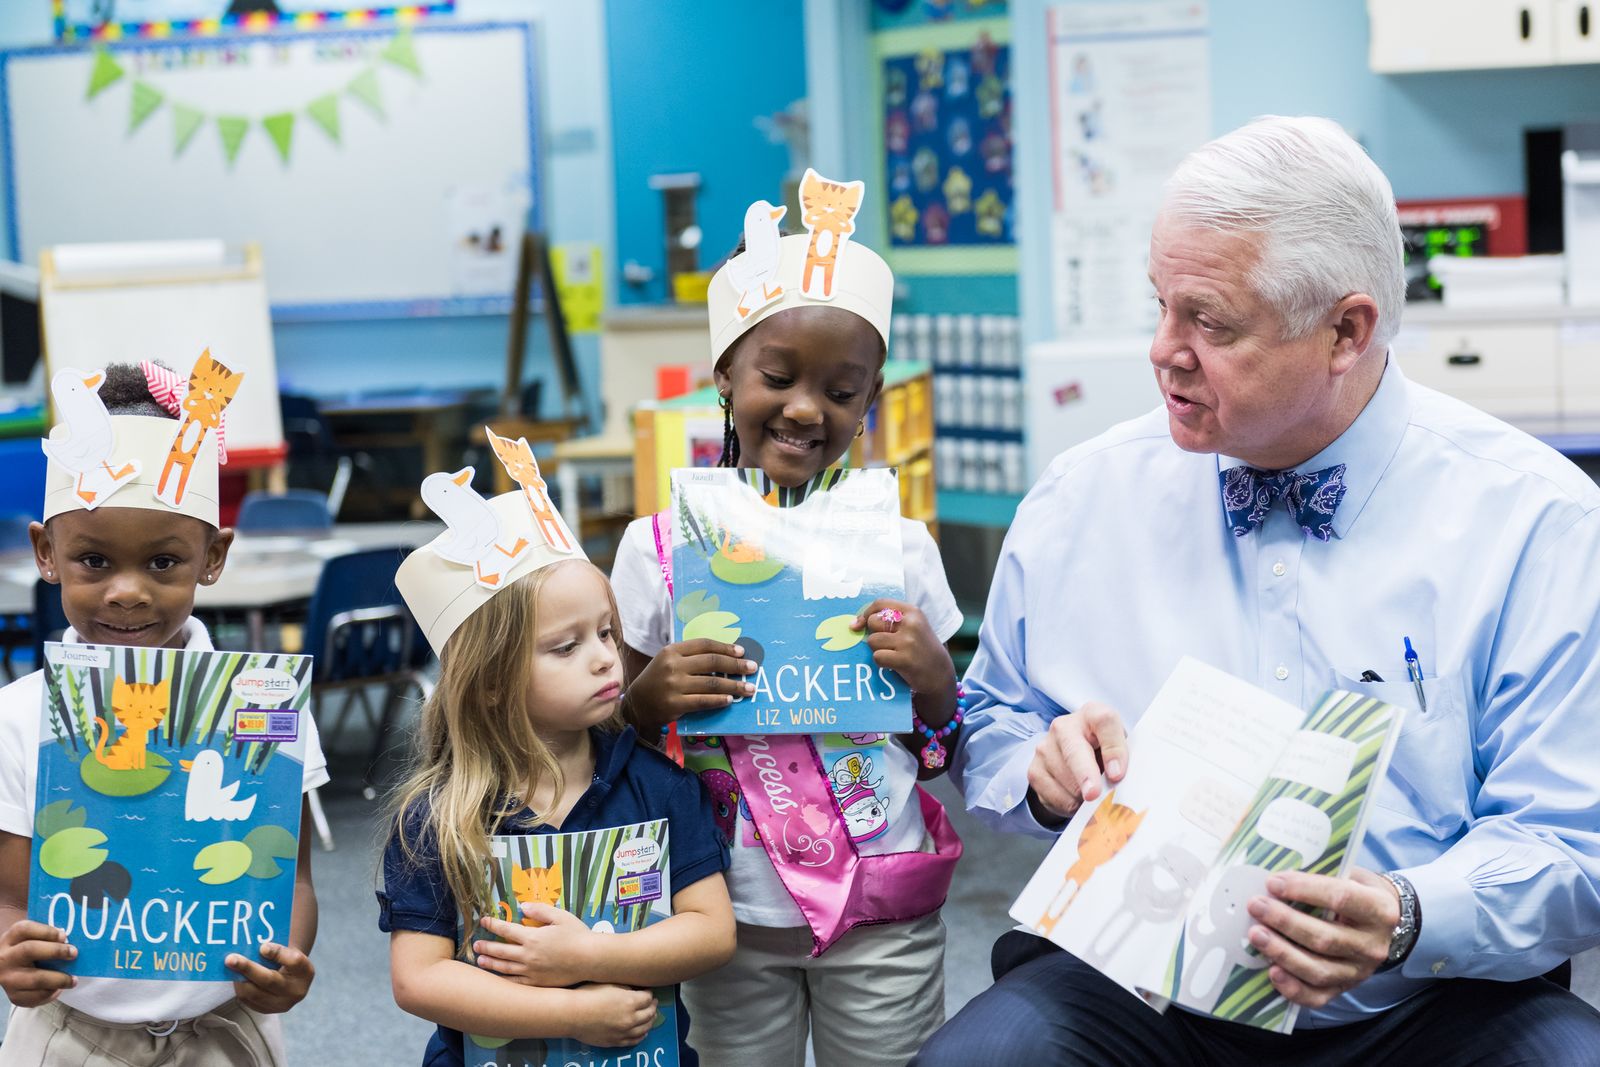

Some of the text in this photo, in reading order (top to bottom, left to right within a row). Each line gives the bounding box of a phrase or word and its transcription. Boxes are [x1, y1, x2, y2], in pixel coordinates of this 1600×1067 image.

[236, 677, 290, 689] Jumpstart
[722, 663, 897, 704] ACKERS
[756, 707, 838, 727] LIZ WONG
[743, 734, 799, 816] ncess
[616, 844, 655, 859] Jumpstart
[48, 892, 276, 945] QUACKERS
[113, 949, 208, 973] LIZ WONG
